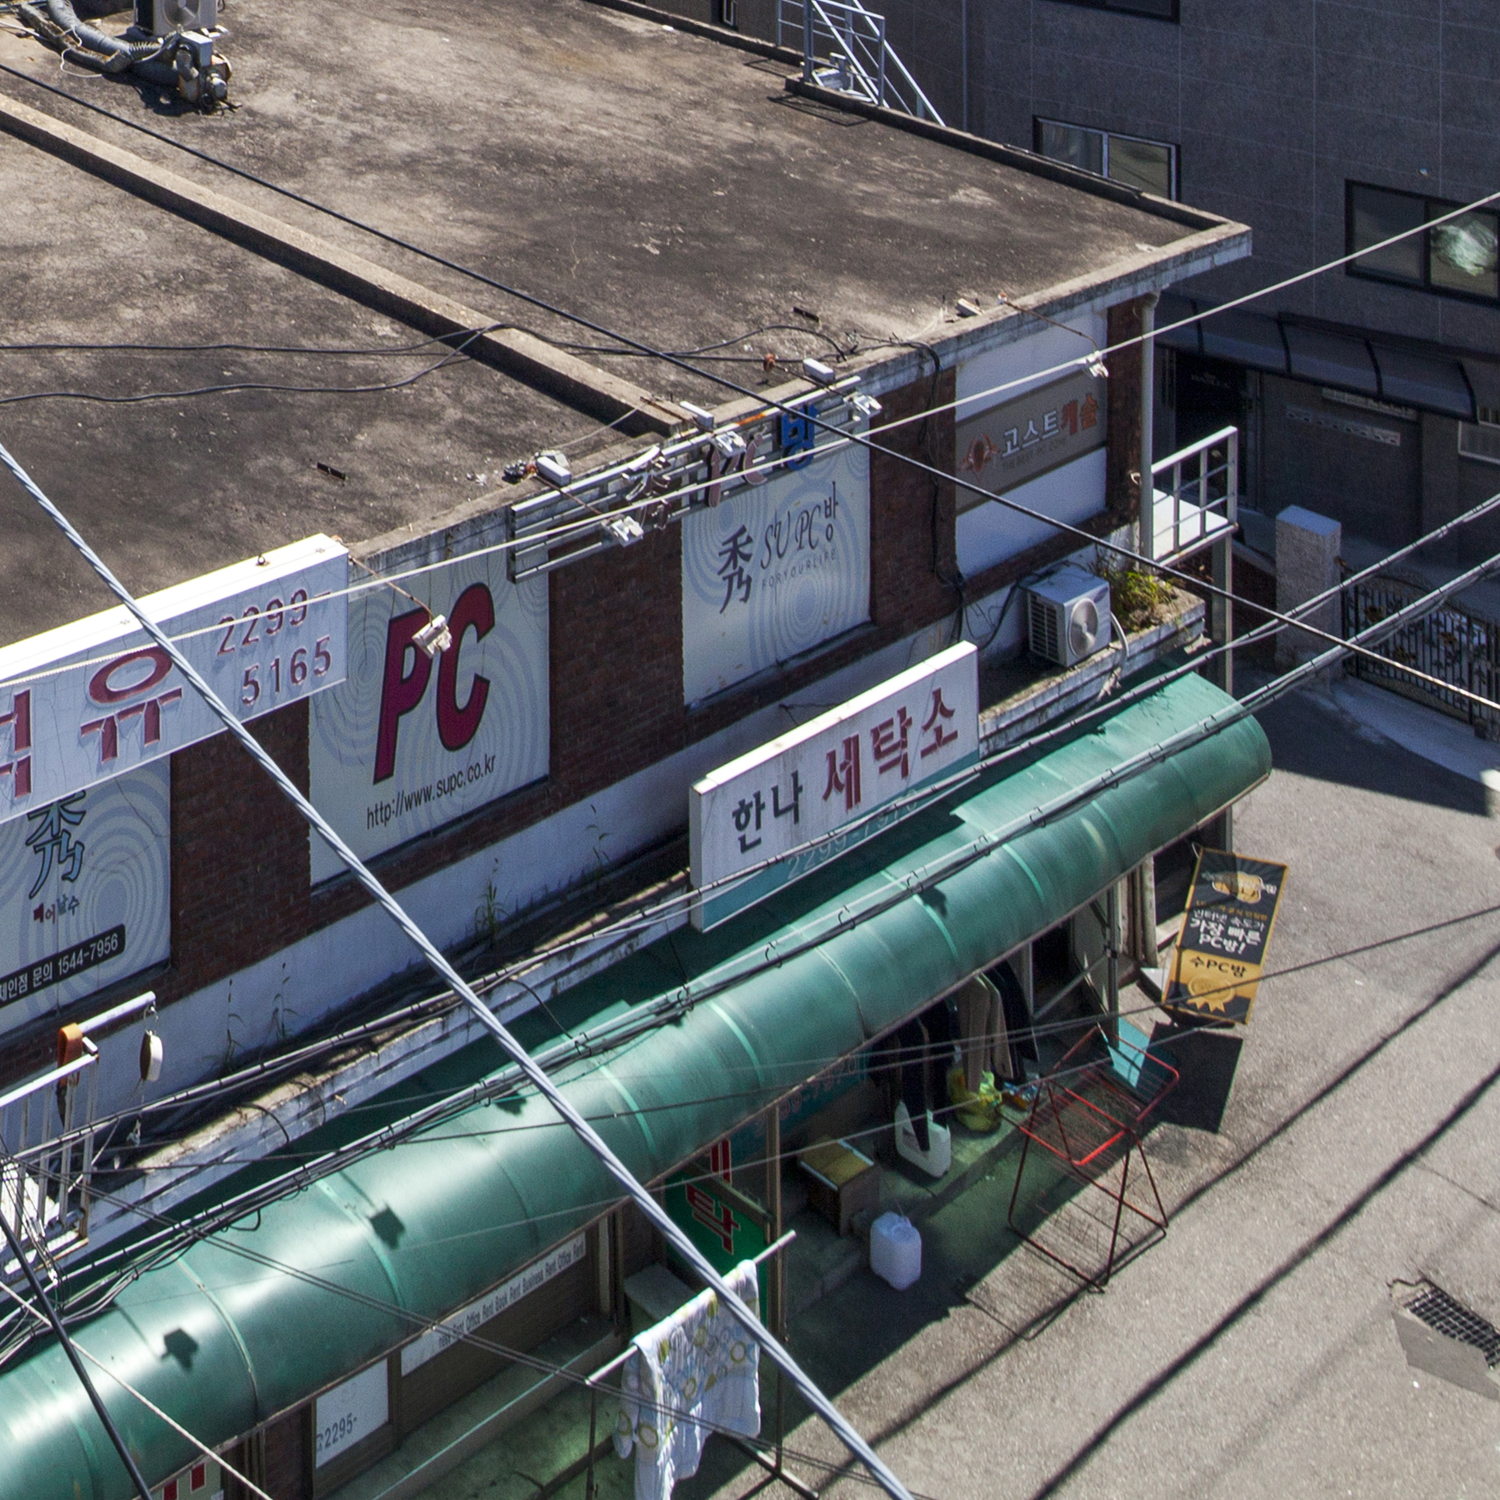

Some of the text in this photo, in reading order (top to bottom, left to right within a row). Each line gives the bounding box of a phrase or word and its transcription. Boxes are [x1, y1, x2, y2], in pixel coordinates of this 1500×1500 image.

[241, 636, 331, 706] 5165
[373, 582, 496, 786] PC
[366, 753, 497, 830] http://www.supc.co.kr
[732, 687, 958, 853] 한나 세탁소
[33, 961, 53, 988] 문의
[57, 933, 119, 976] 1544-7956
[1190, 918, 1261, 946] 가장 빠른
[1199, 934, 1247, 955] PC방!
[1189, 956, 1248, 978] 수PC방
